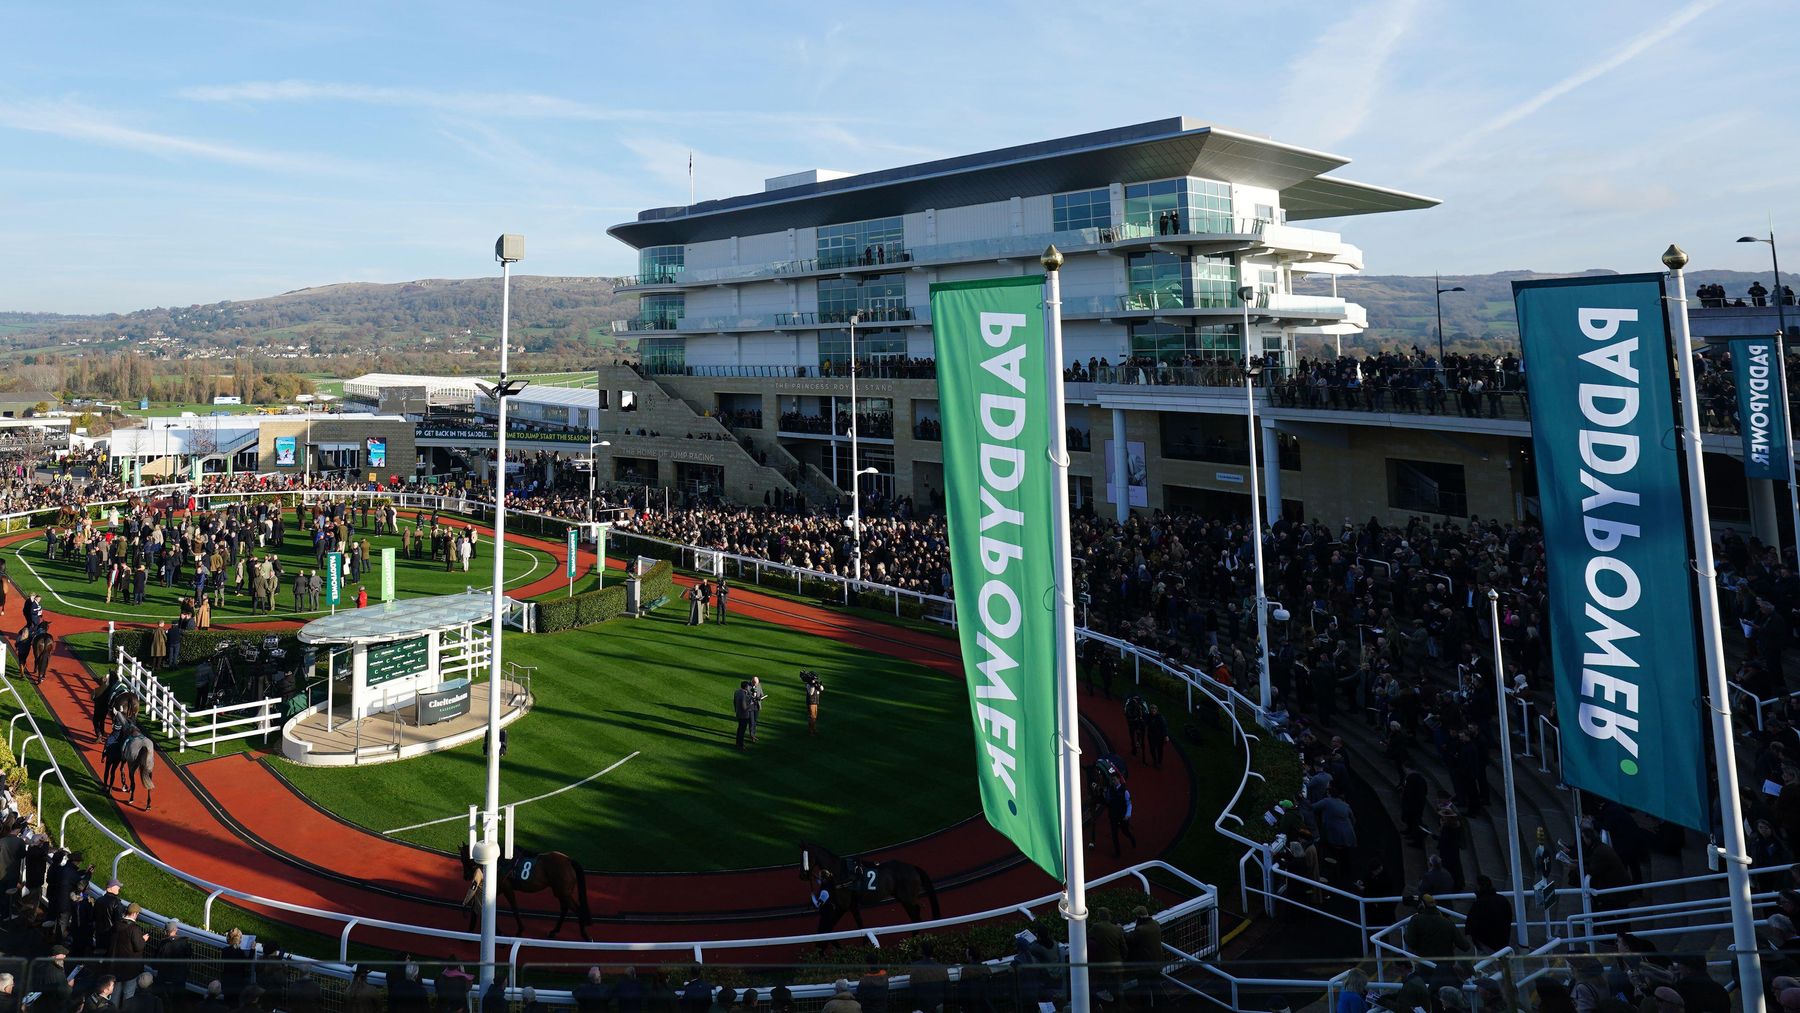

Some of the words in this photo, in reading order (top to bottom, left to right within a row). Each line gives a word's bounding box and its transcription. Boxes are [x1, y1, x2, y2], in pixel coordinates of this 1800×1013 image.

[833, 383, 860, 391] ROYL
[865, 384, 893, 392] STAND
[567, 434, 590, 442] SEASON!
[636, 448, 657, 457] HOME
[659, 449, 667, 458] OF
[670, 450, 687, 459] JUMP
[689, 451, 714, 461] RACING
[428, 692, 468, 708] Cheltenham
[520, 861, 532, 880] 8
[867, 870, 876, 891] 2
